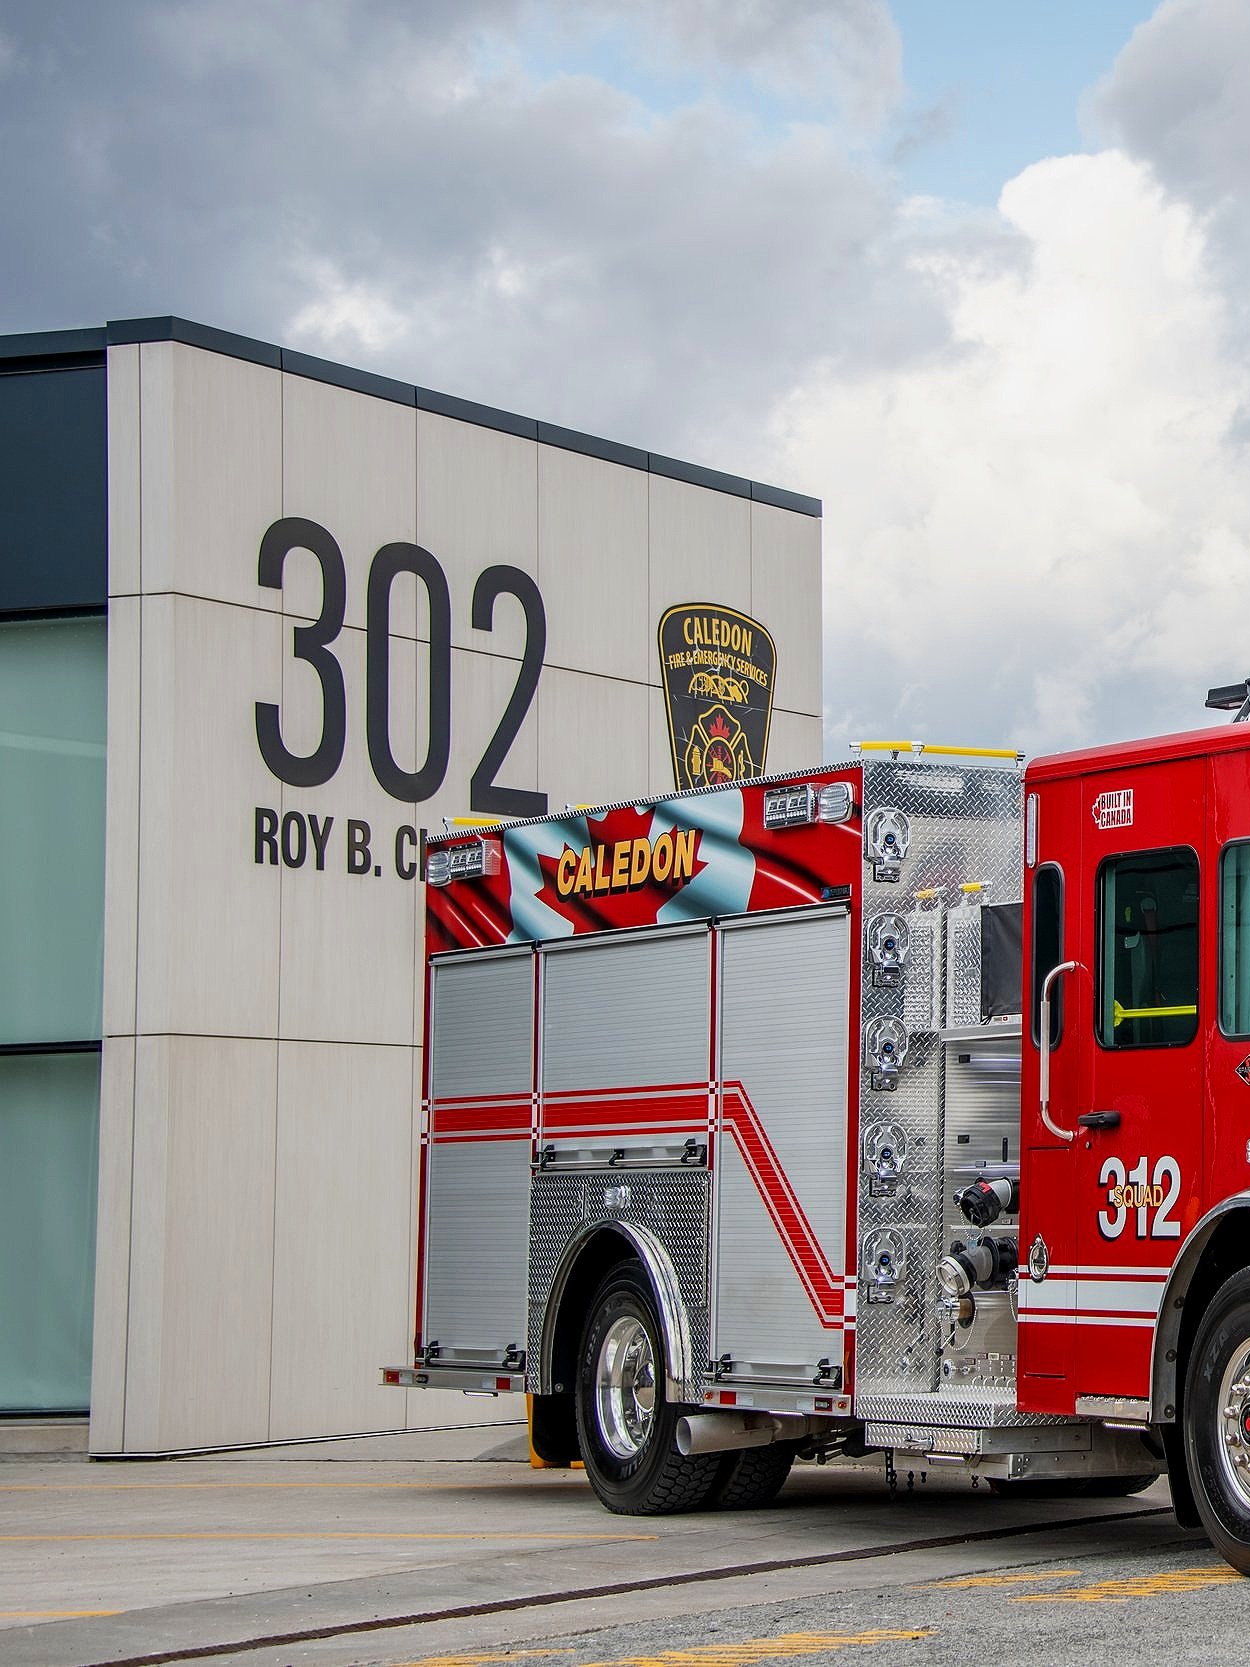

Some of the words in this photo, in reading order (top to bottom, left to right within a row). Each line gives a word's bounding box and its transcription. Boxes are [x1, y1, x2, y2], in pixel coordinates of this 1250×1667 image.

[683, 617, 752, 656] CALEDON
[255, 517, 548, 818] 302
[668, 651, 686, 670] FIRE
[686, 651, 693, 665] &
[693, 650, 736, 671] EMERGENCY
[736, 658, 768, 687] SERVICES
[1101, 792, 1121, 810] BUILT
[1123, 790, 1132, 807] IN
[1101, 809, 1131, 827] CANADA
[255, 807, 334, 871] ROY
[347, 819, 382, 877] B.
[556, 829, 698, 898] CALEDON
[1098, 1155, 1180, 1239] 312
[1113, 1184, 1164, 1208] SQUAD
